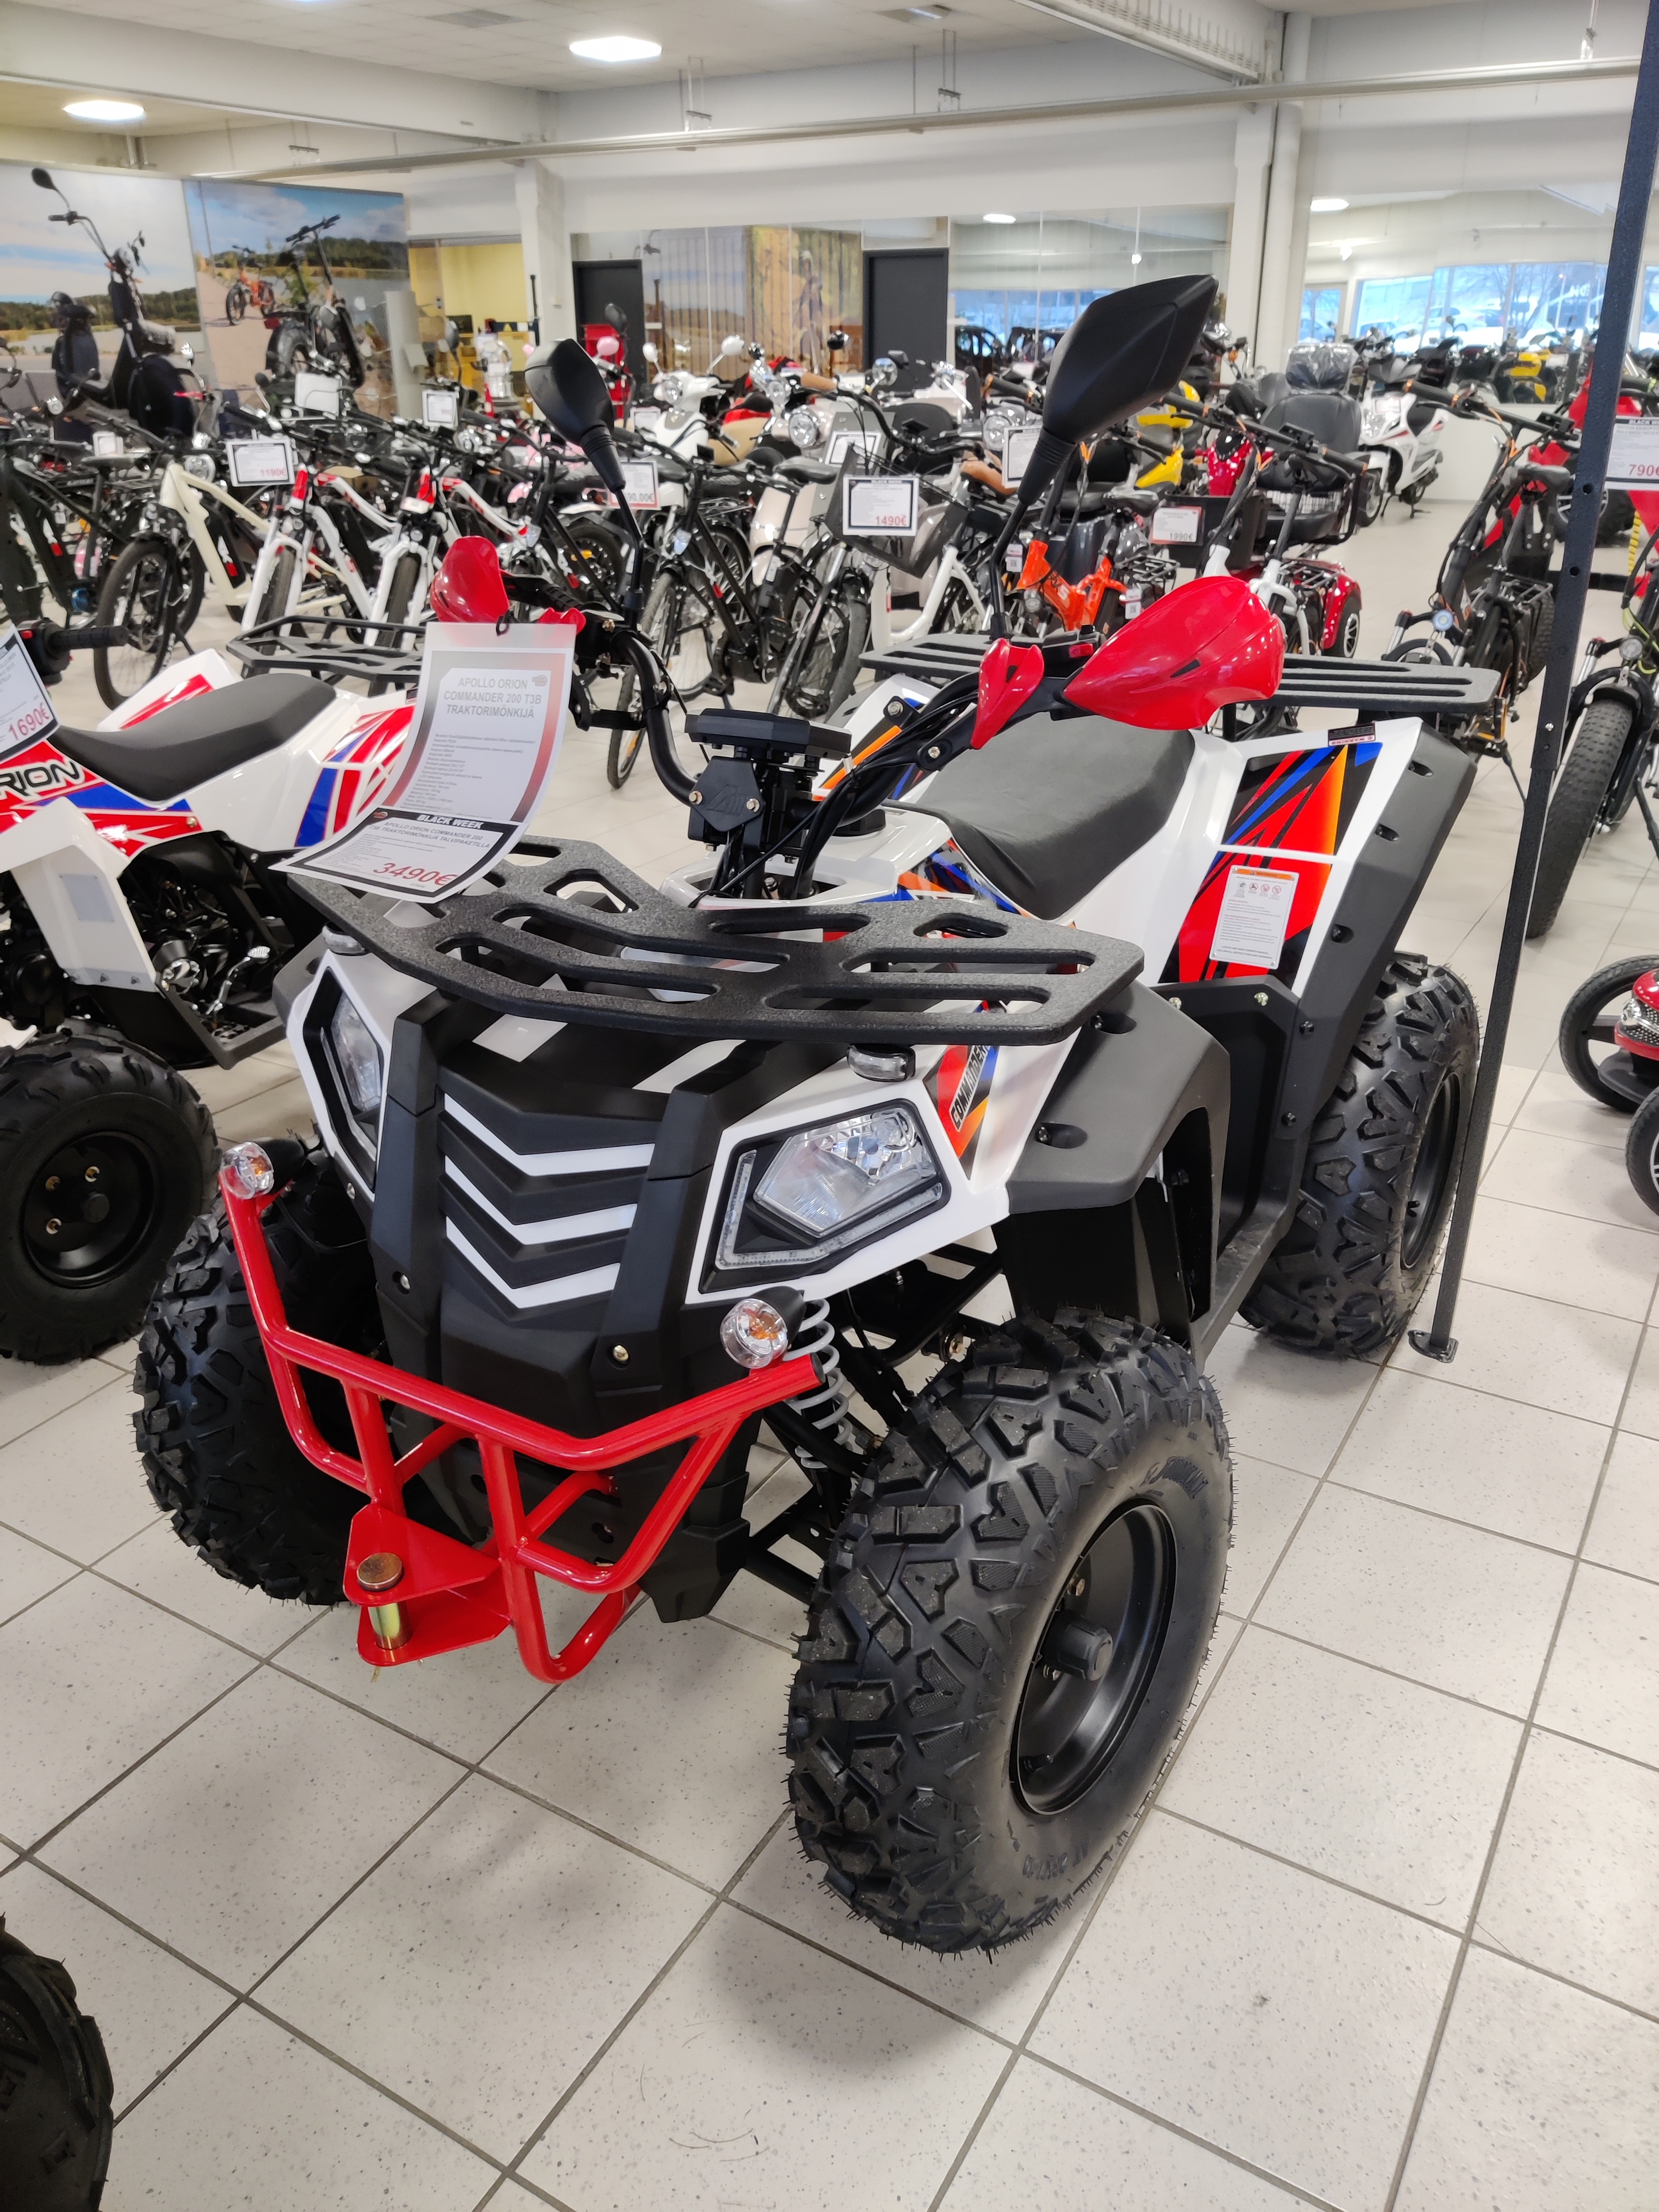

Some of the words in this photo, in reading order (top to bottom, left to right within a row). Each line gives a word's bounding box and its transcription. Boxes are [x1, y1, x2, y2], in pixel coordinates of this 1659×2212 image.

[875, 515, 907, 526] 1490€
[1170, 532, 1194, 541] 1990€
[458, 677, 495, 688] APOLLO
[497, 679, 528, 690] ORION
[444, 691, 504, 703] COMMANDER
[506, 693, 521, 704] 200
[524, 694, 542, 705] T3B
[447, 705, 534, 718] TRAKTORIMÖNKIJÄ
[8, 702, 50, 741] 1690€
[417, 814, 452, 826] BLACK
[452, 817, 484, 829] WEEK
[430, 828, 474, 839] COMMANDER
[440, 836, 490, 848] TALVIPAKETILLA
[373, 863, 458, 886] 3490€
